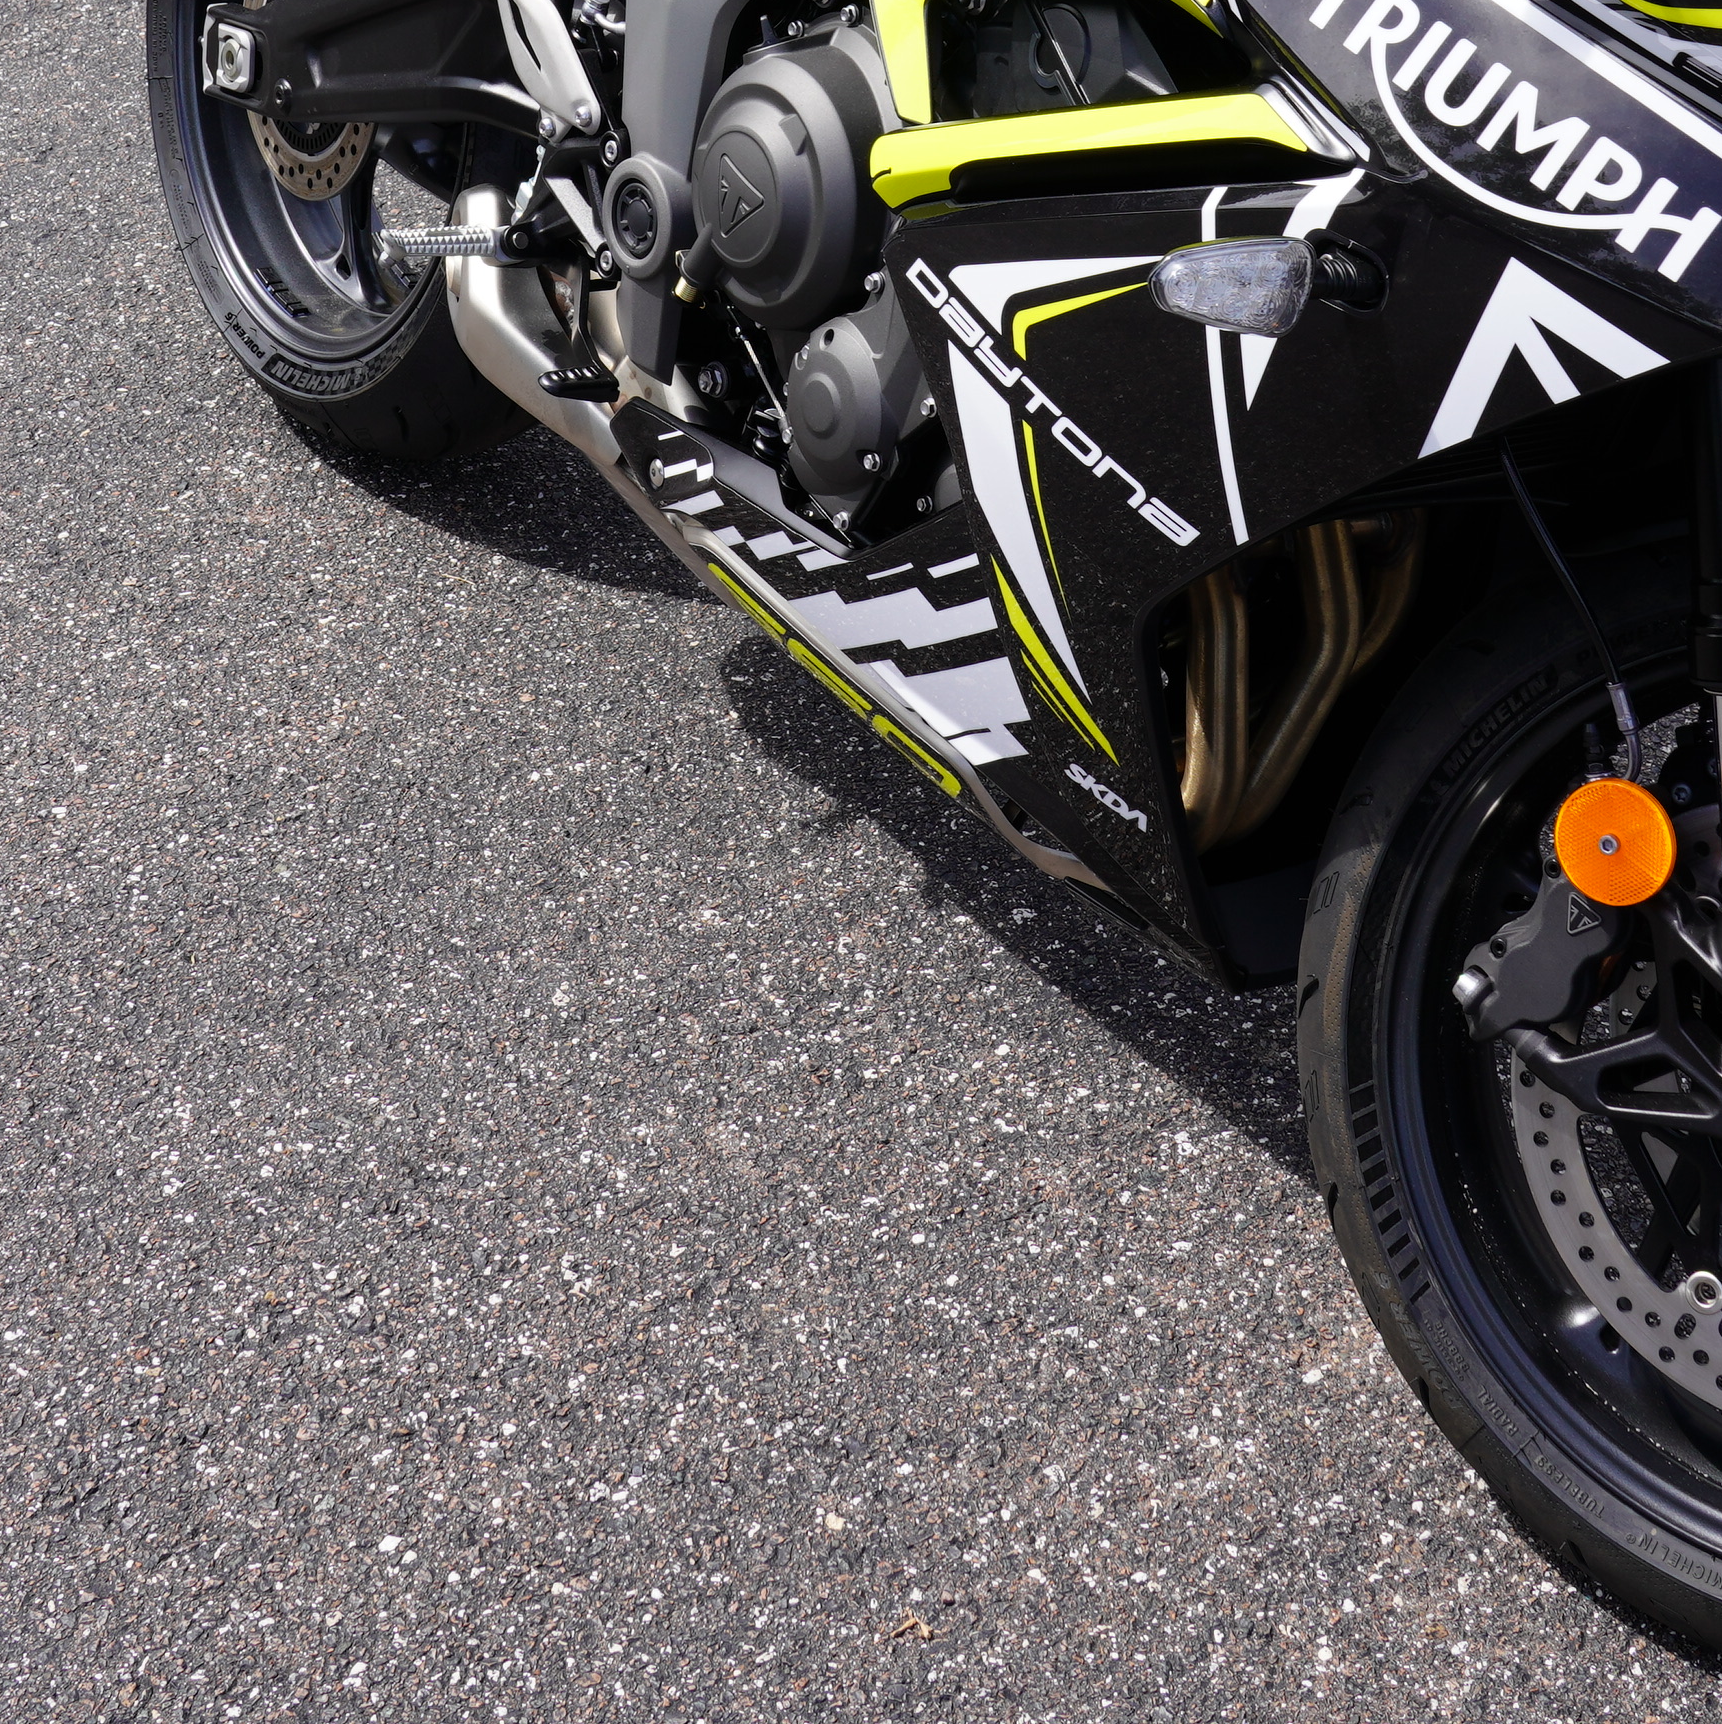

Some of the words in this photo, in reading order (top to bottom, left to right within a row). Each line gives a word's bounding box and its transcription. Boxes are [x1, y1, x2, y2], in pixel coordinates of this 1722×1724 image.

[232, 321, 266, 360] POWER
[271, 360, 352, 393] MICHELIN
[1444, 672, 1551, 779] MICHELIN
[1478, 1385, 1520, 1437] RADIAL
[1534, 1453, 1605, 1518] TUBELESS
